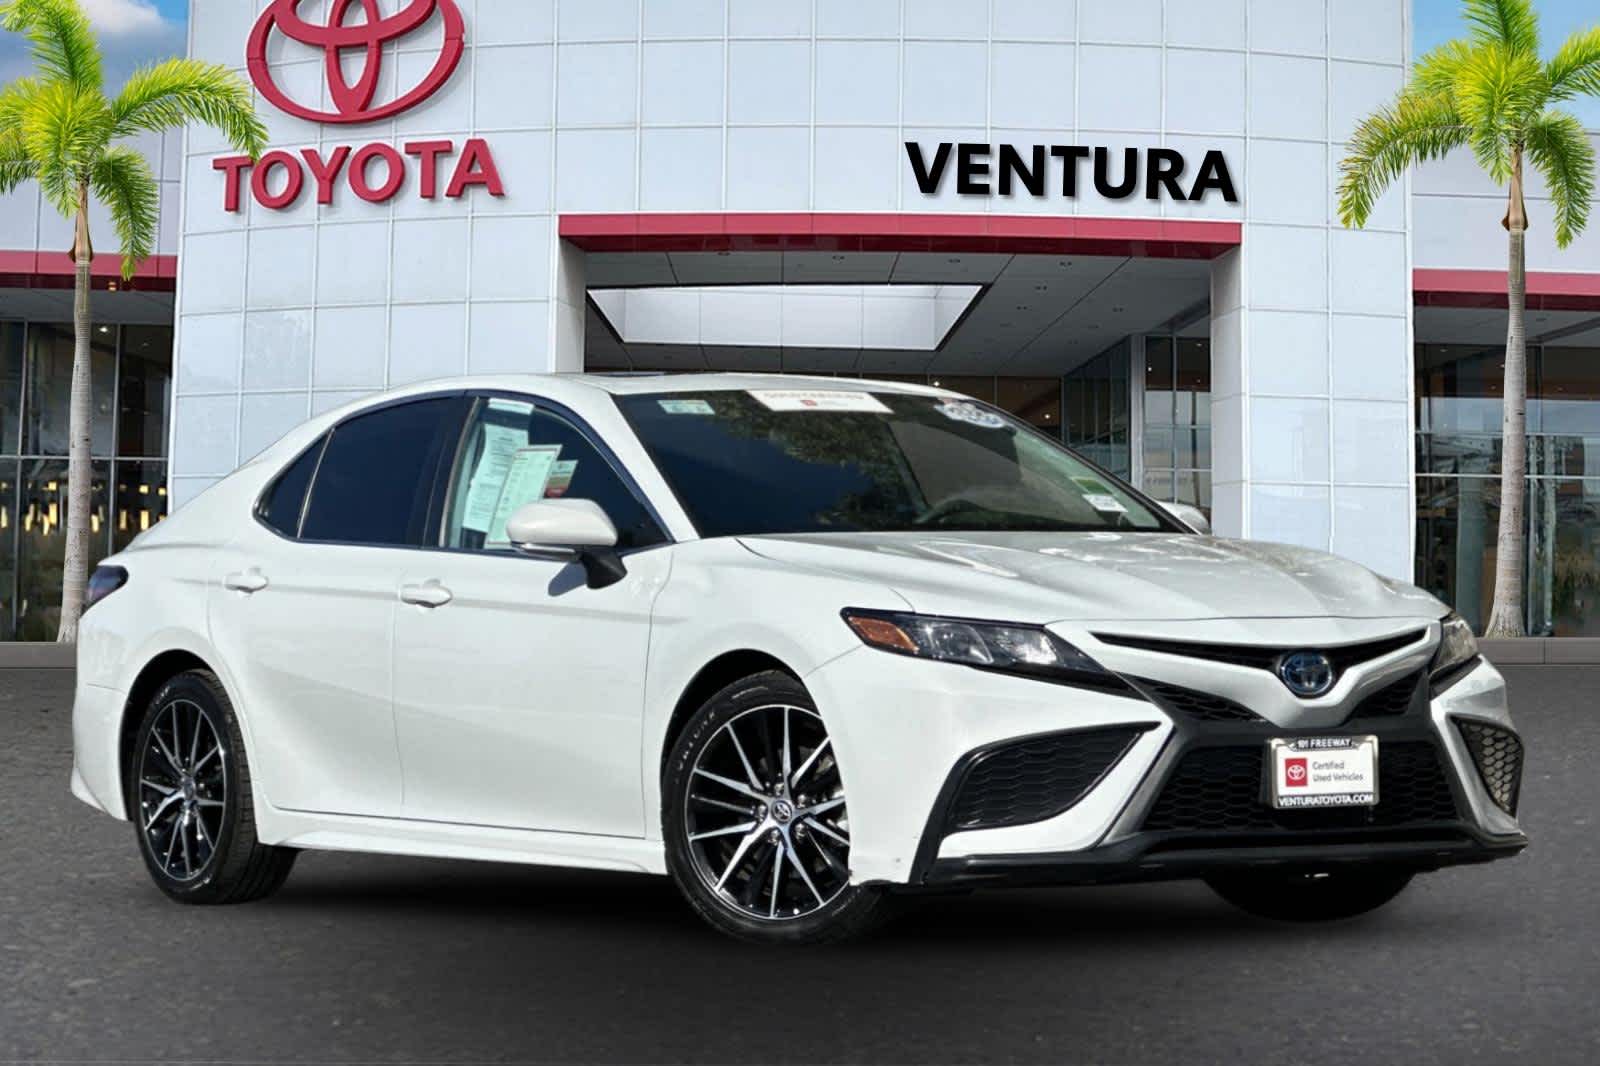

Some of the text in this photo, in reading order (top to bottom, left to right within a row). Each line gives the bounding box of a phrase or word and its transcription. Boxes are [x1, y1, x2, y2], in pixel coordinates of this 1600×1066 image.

[213, 138, 505, 212] TOYOTA
[905, 141, 1238, 202] VENTURA
[1311, 739, 1350, 748] FREEWAY
[1312, 761, 1345, 770] Certified
[1334, 773, 1364, 781] Vehicles
[1278, 794, 1373, 806] VENTURATOYOTA.COM
